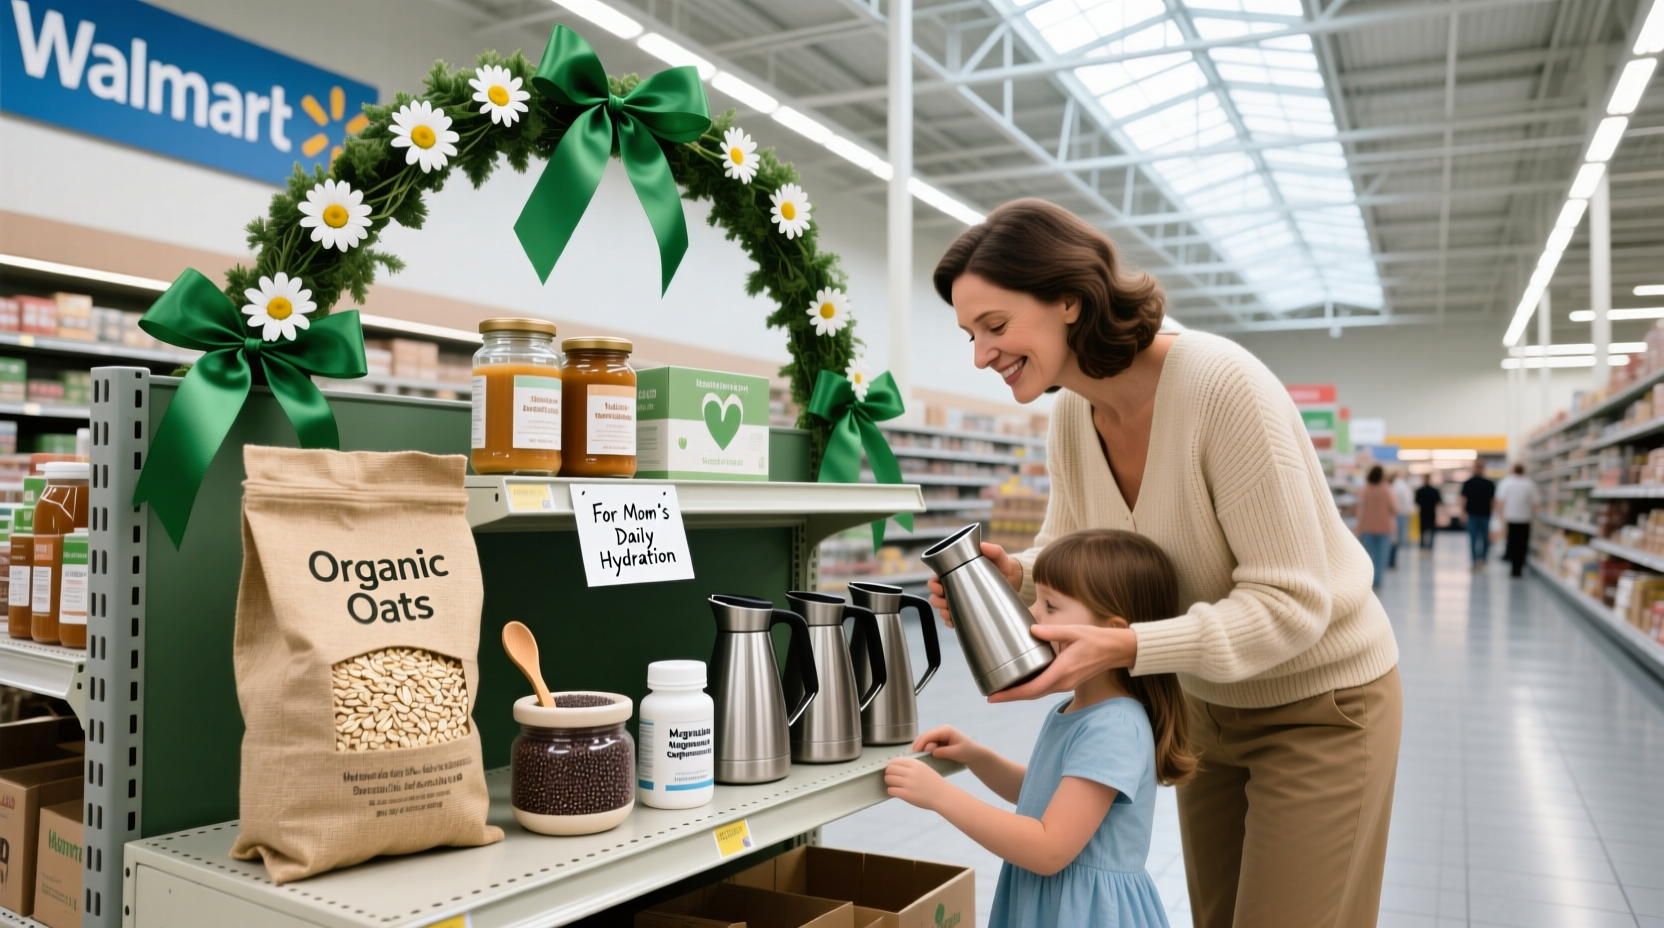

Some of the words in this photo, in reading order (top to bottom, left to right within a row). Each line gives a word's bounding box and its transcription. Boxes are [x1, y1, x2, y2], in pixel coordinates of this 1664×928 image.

[11, 0, 293, 153] Walmart
[592, 502, 618, 524] For
[623, 502, 670, 522] Mom's
[614, 526, 655, 550] Daily
[308, 548, 450, 591] Organic
[599, 548, 677, 578] Hydration
[347, 592, 434, 625] Oats
